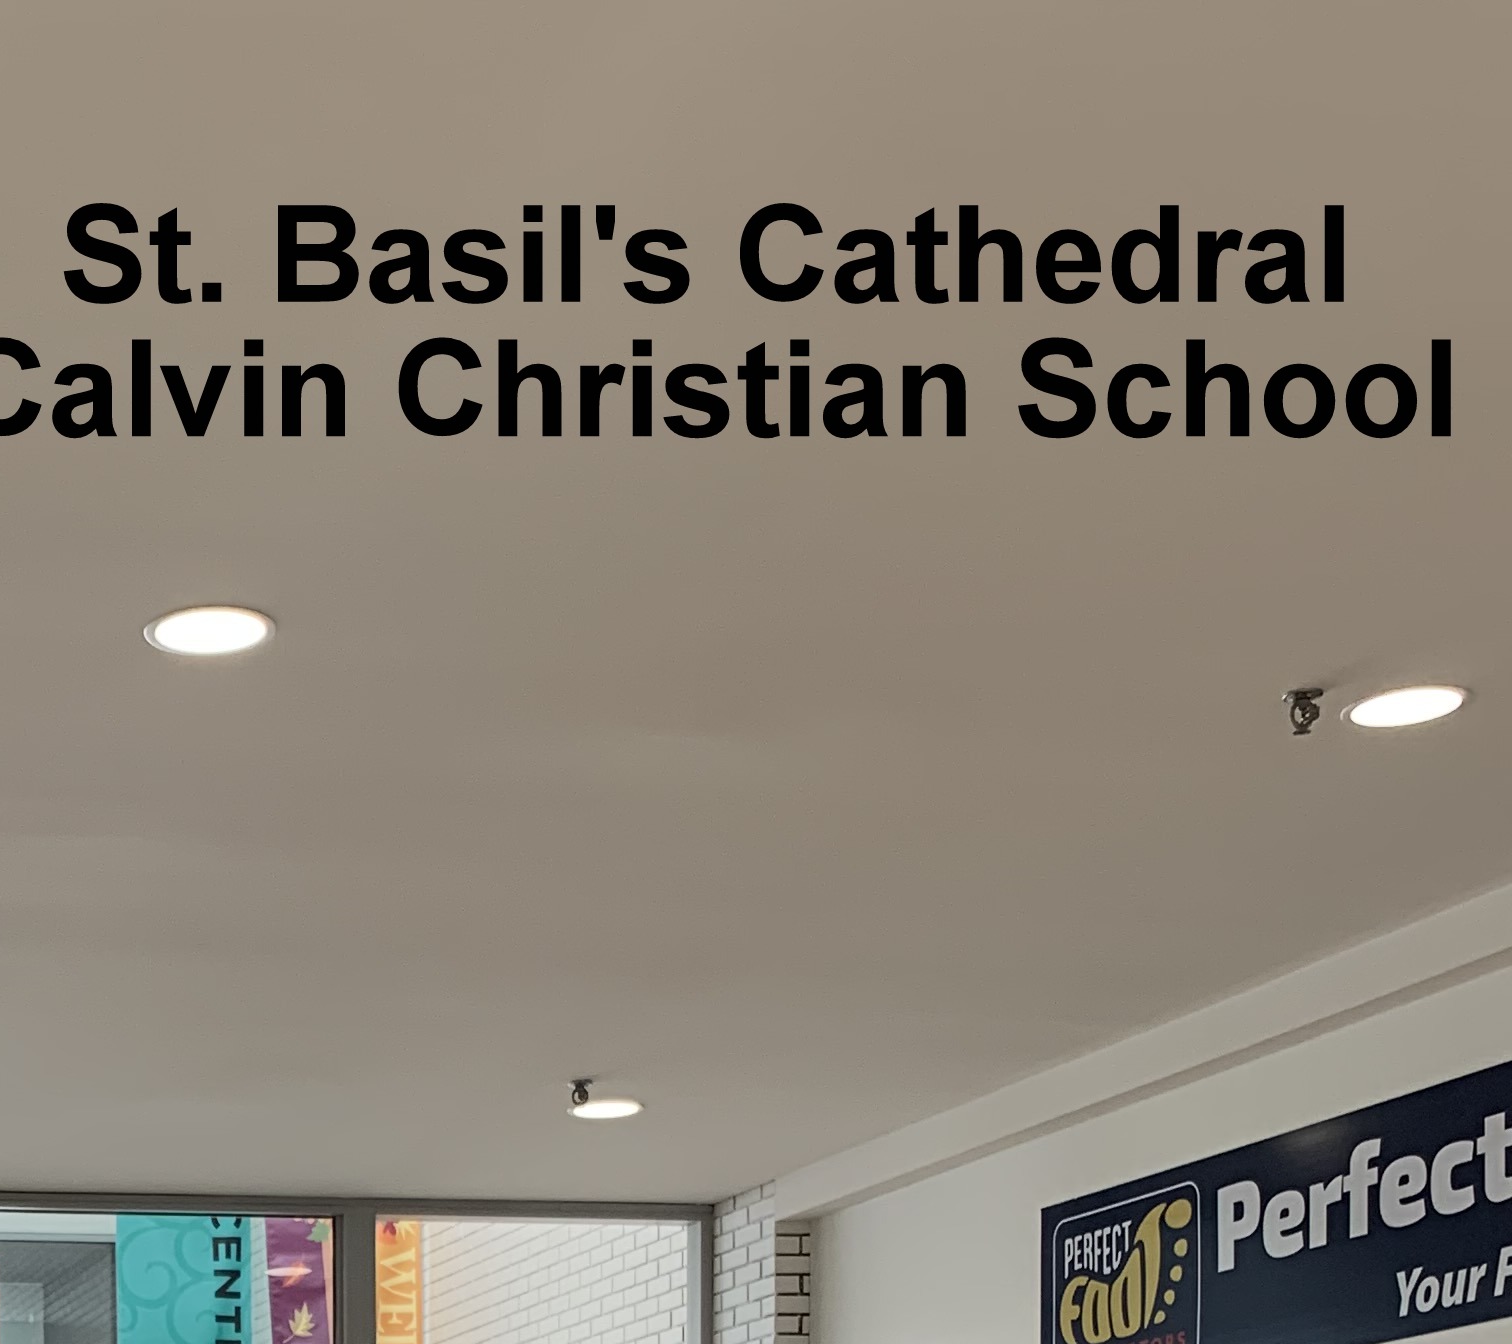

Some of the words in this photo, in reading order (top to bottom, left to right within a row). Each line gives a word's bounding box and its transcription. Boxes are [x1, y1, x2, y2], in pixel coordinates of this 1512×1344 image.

[1217, 1111, 1512, 1273] Perfect
[1064, 1220, 1132, 1279] PERFECT
[1396, 1262, 1487, 1318] Your
